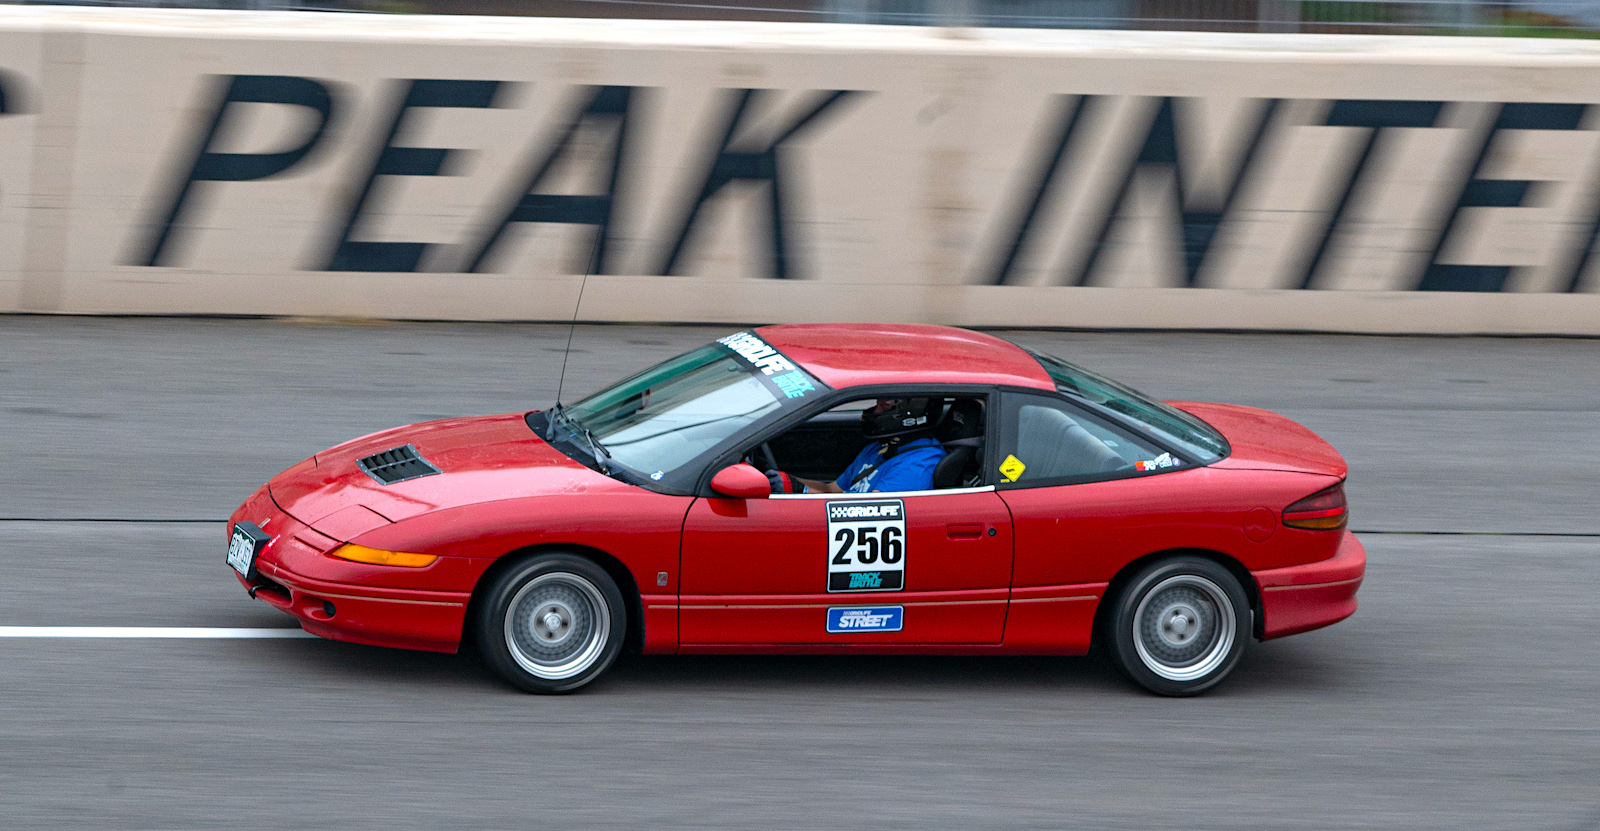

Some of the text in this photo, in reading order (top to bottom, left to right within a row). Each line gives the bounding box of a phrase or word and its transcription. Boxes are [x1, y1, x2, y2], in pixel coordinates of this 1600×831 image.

[122, 74, 1600, 293] PEAK INTE
[727, 333, 796, 376] GRIDLIFE
[771, 375, 805, 399] BATTLE
[784, 369, 816, 391] TRACK
[846, 505, 900, 517] GRIDLIFE
[831, 526, 902, 565] 256
[848, 579, 883, 588] BATTLE
[849, 572, 881, 580] TRACK
[838, 614, 894, 628] STREET
